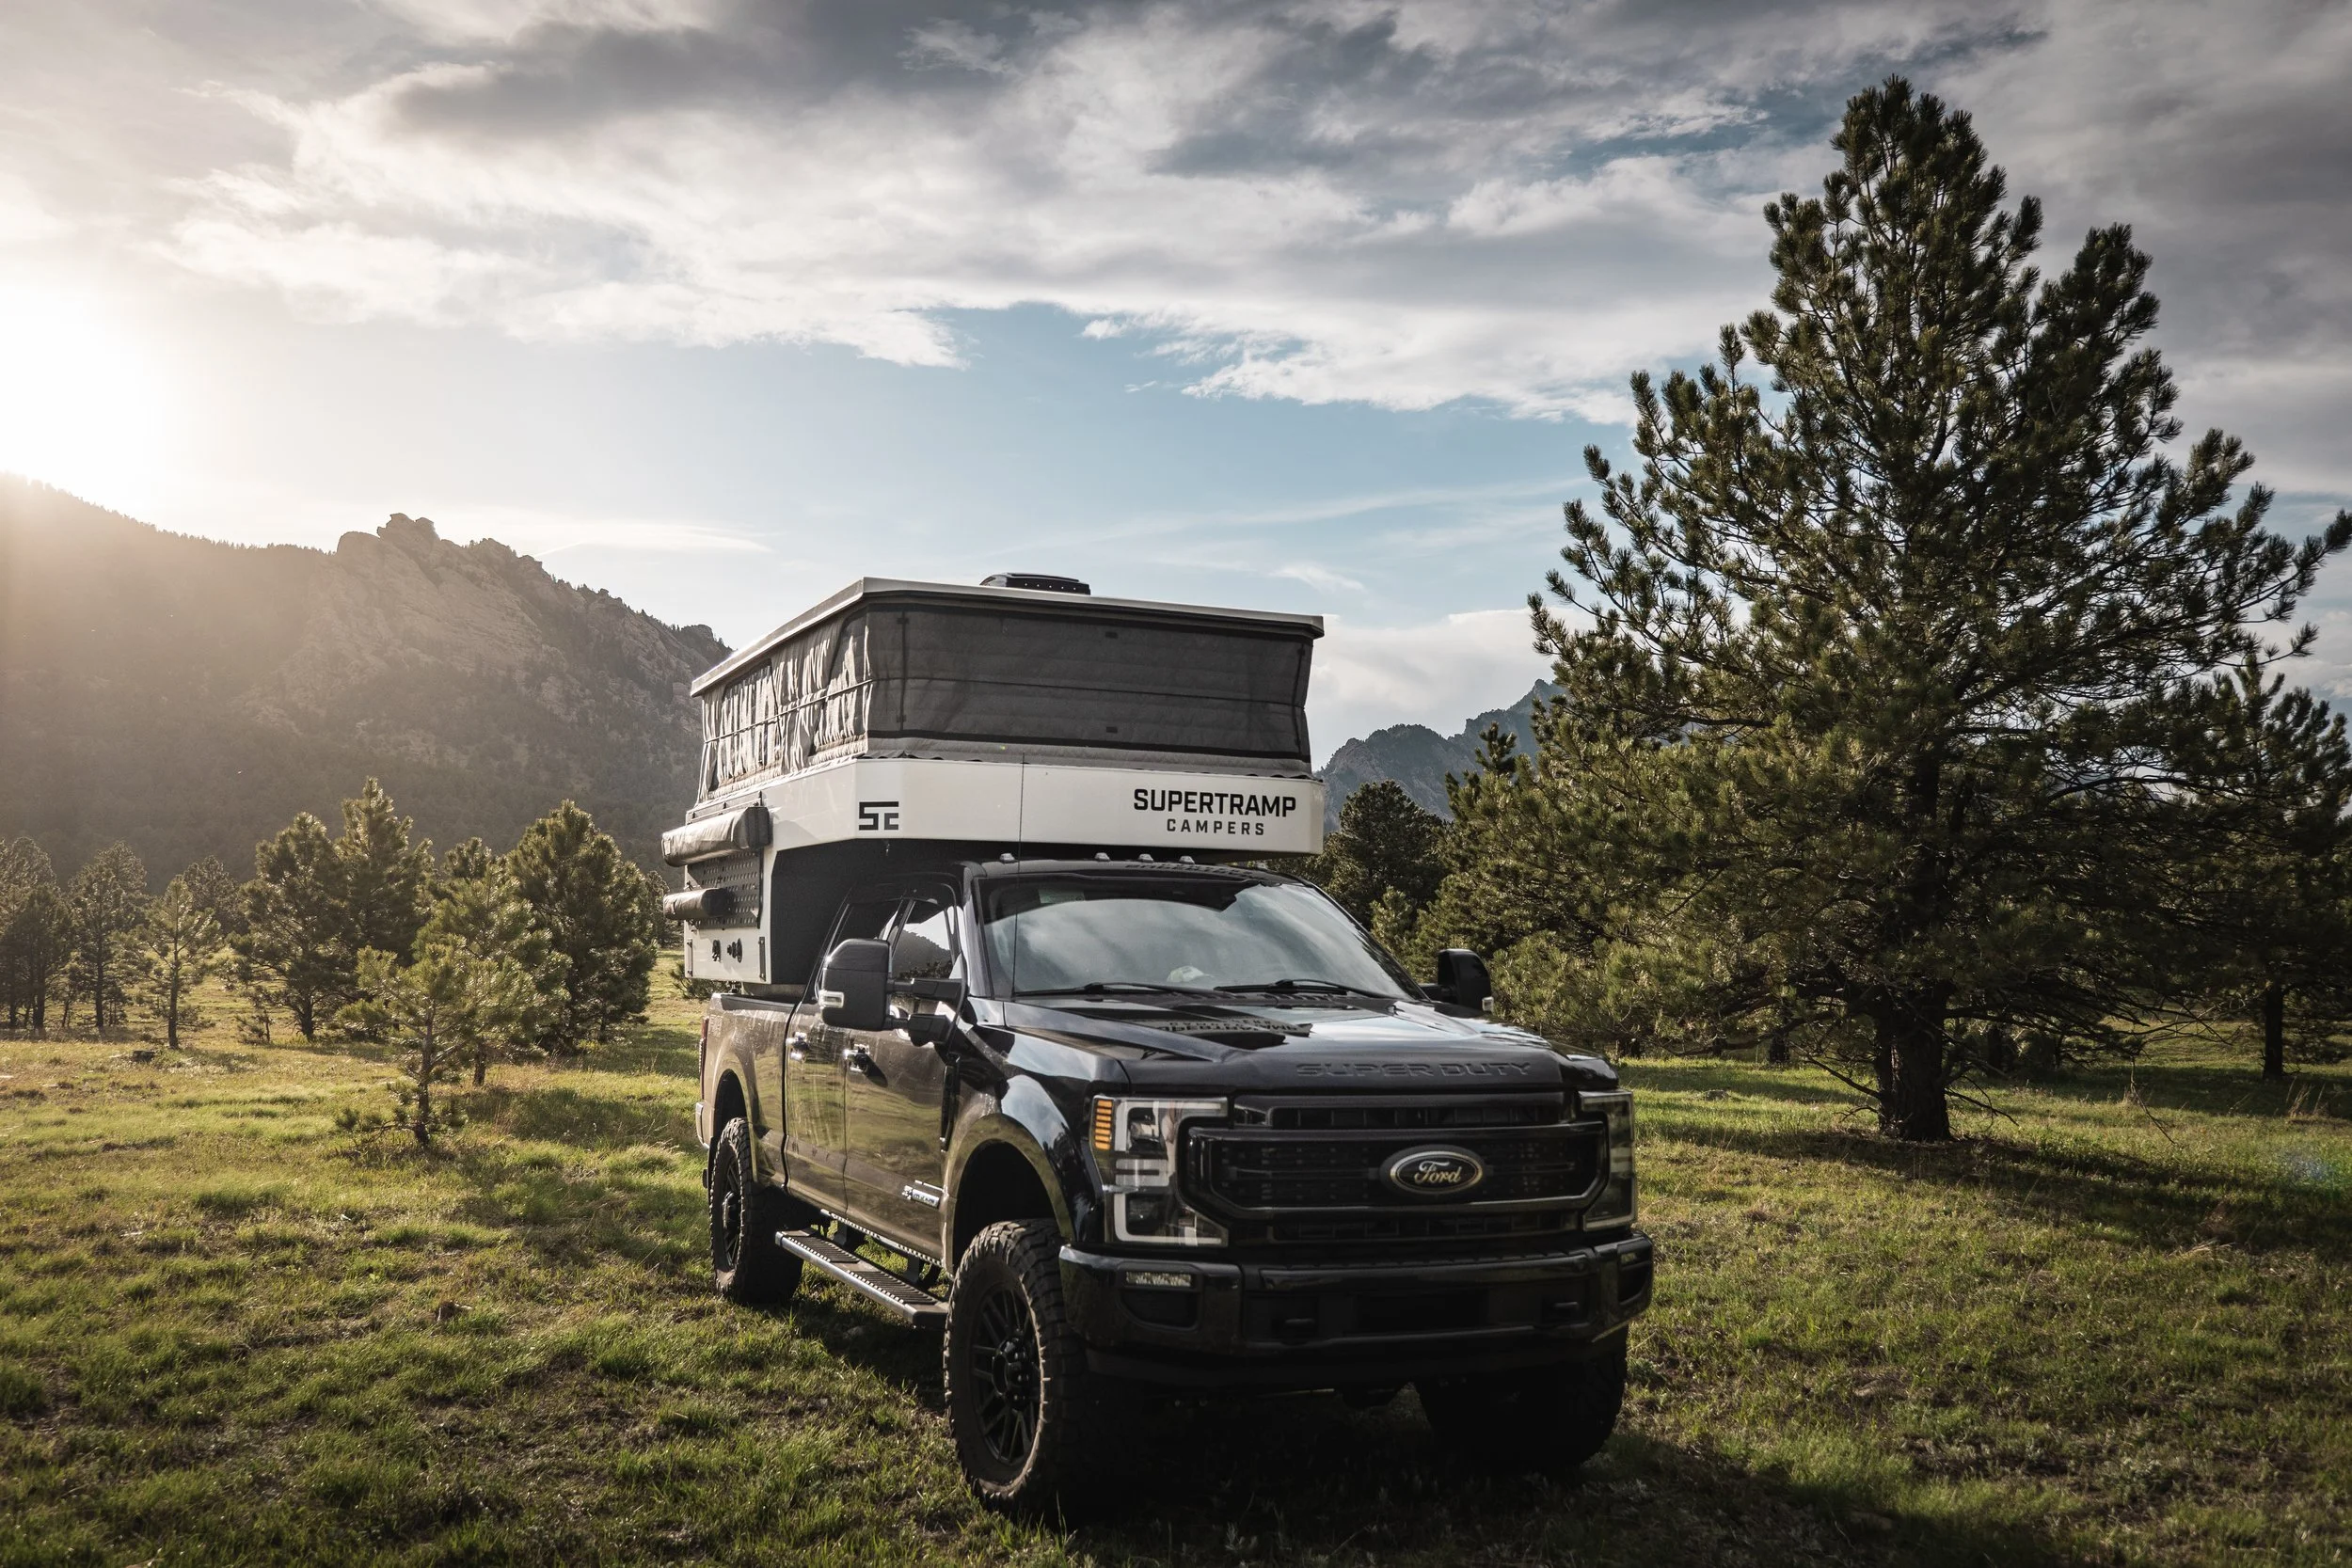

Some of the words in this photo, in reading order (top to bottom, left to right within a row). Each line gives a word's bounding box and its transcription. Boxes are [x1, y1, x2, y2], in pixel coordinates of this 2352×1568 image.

[1134, 788, 1296, 817] SUPERTRAMP
[1167, 818, 1264, 835] CAMPERS
[1296, 1063, 1434, 1077] SUPER
[1438, 1062, 1531, 1076] DUTY
[1413, 1160, 1462, 1183] Ford
